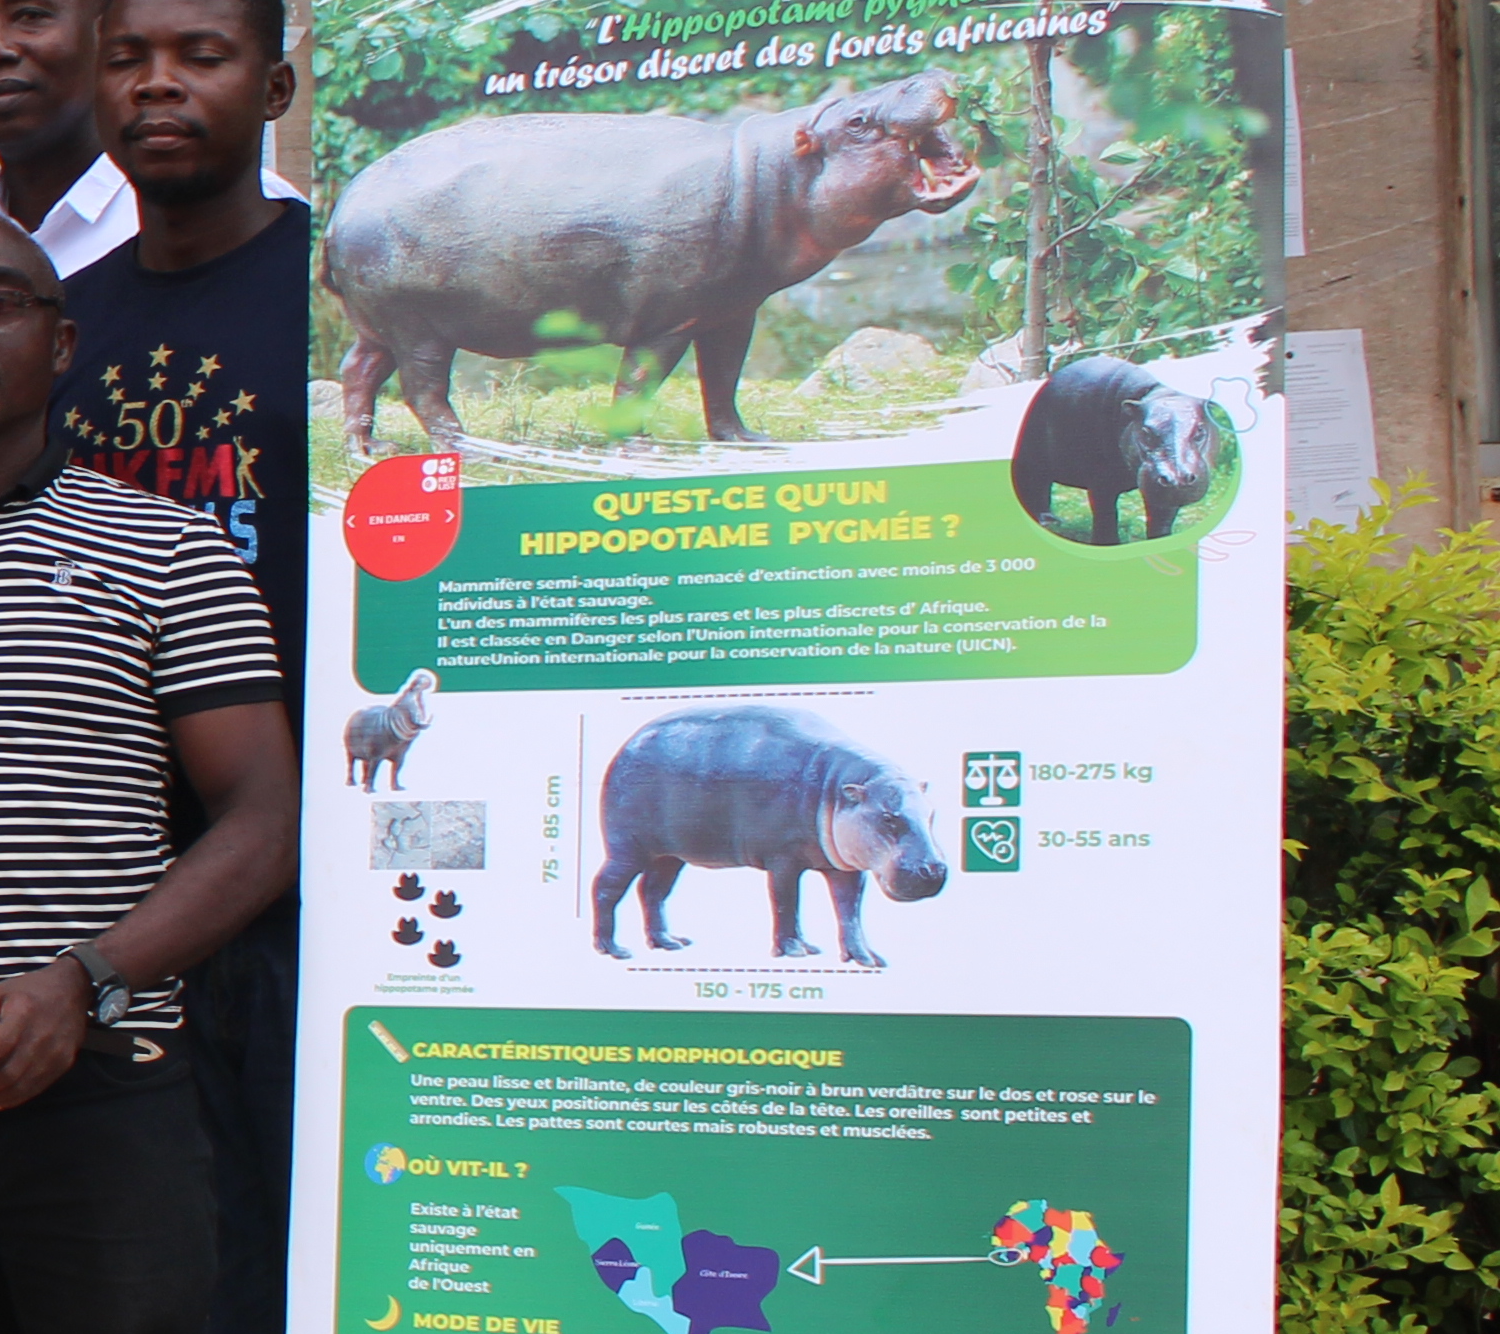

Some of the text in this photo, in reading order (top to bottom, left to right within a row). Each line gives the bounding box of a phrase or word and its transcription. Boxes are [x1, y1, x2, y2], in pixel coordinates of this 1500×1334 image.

[484, 72, 524, 96] un
[533, 54, 628, 89] trésor
[637, 41, 744, 81] discret
[755, 35, 815, 69] des
[825, 23, 924, 68] forêts
[592, 480, 885, 521] QU'EST-CE QU'UN
[368, 512, 431, 525] EN DANGER
[520, 510, 958, 555] HIPPOPOTAME PYGMÉE ?
[438, 557, 1035, 592] Mammifère semi-aquatique menacé d'extinction avec moins de 3 000
[438, 595, 653, 611] individus à l'état sauvage.
[1029, 761, 1153, 784] 180-275 kg
[541, 775, 561, 884] 75 85 cm
[1037, 830, 1151, 849] 30-55 ans
[374, 983, 438, 996] hippopotame
[386, 972, 461, 984] Empreinte d'un
[694, 982, 824, 1001] 150 175 cm
[412, 1040, 845, 1069] CARACTÉRISTIQUES MORPHOLOGIQUE
[408, 1155, 530, 1179] OÙ VIT-IL ?
[414, 1312, 480, 1333] MODE
[486, 1316, 518, 1334] DE
